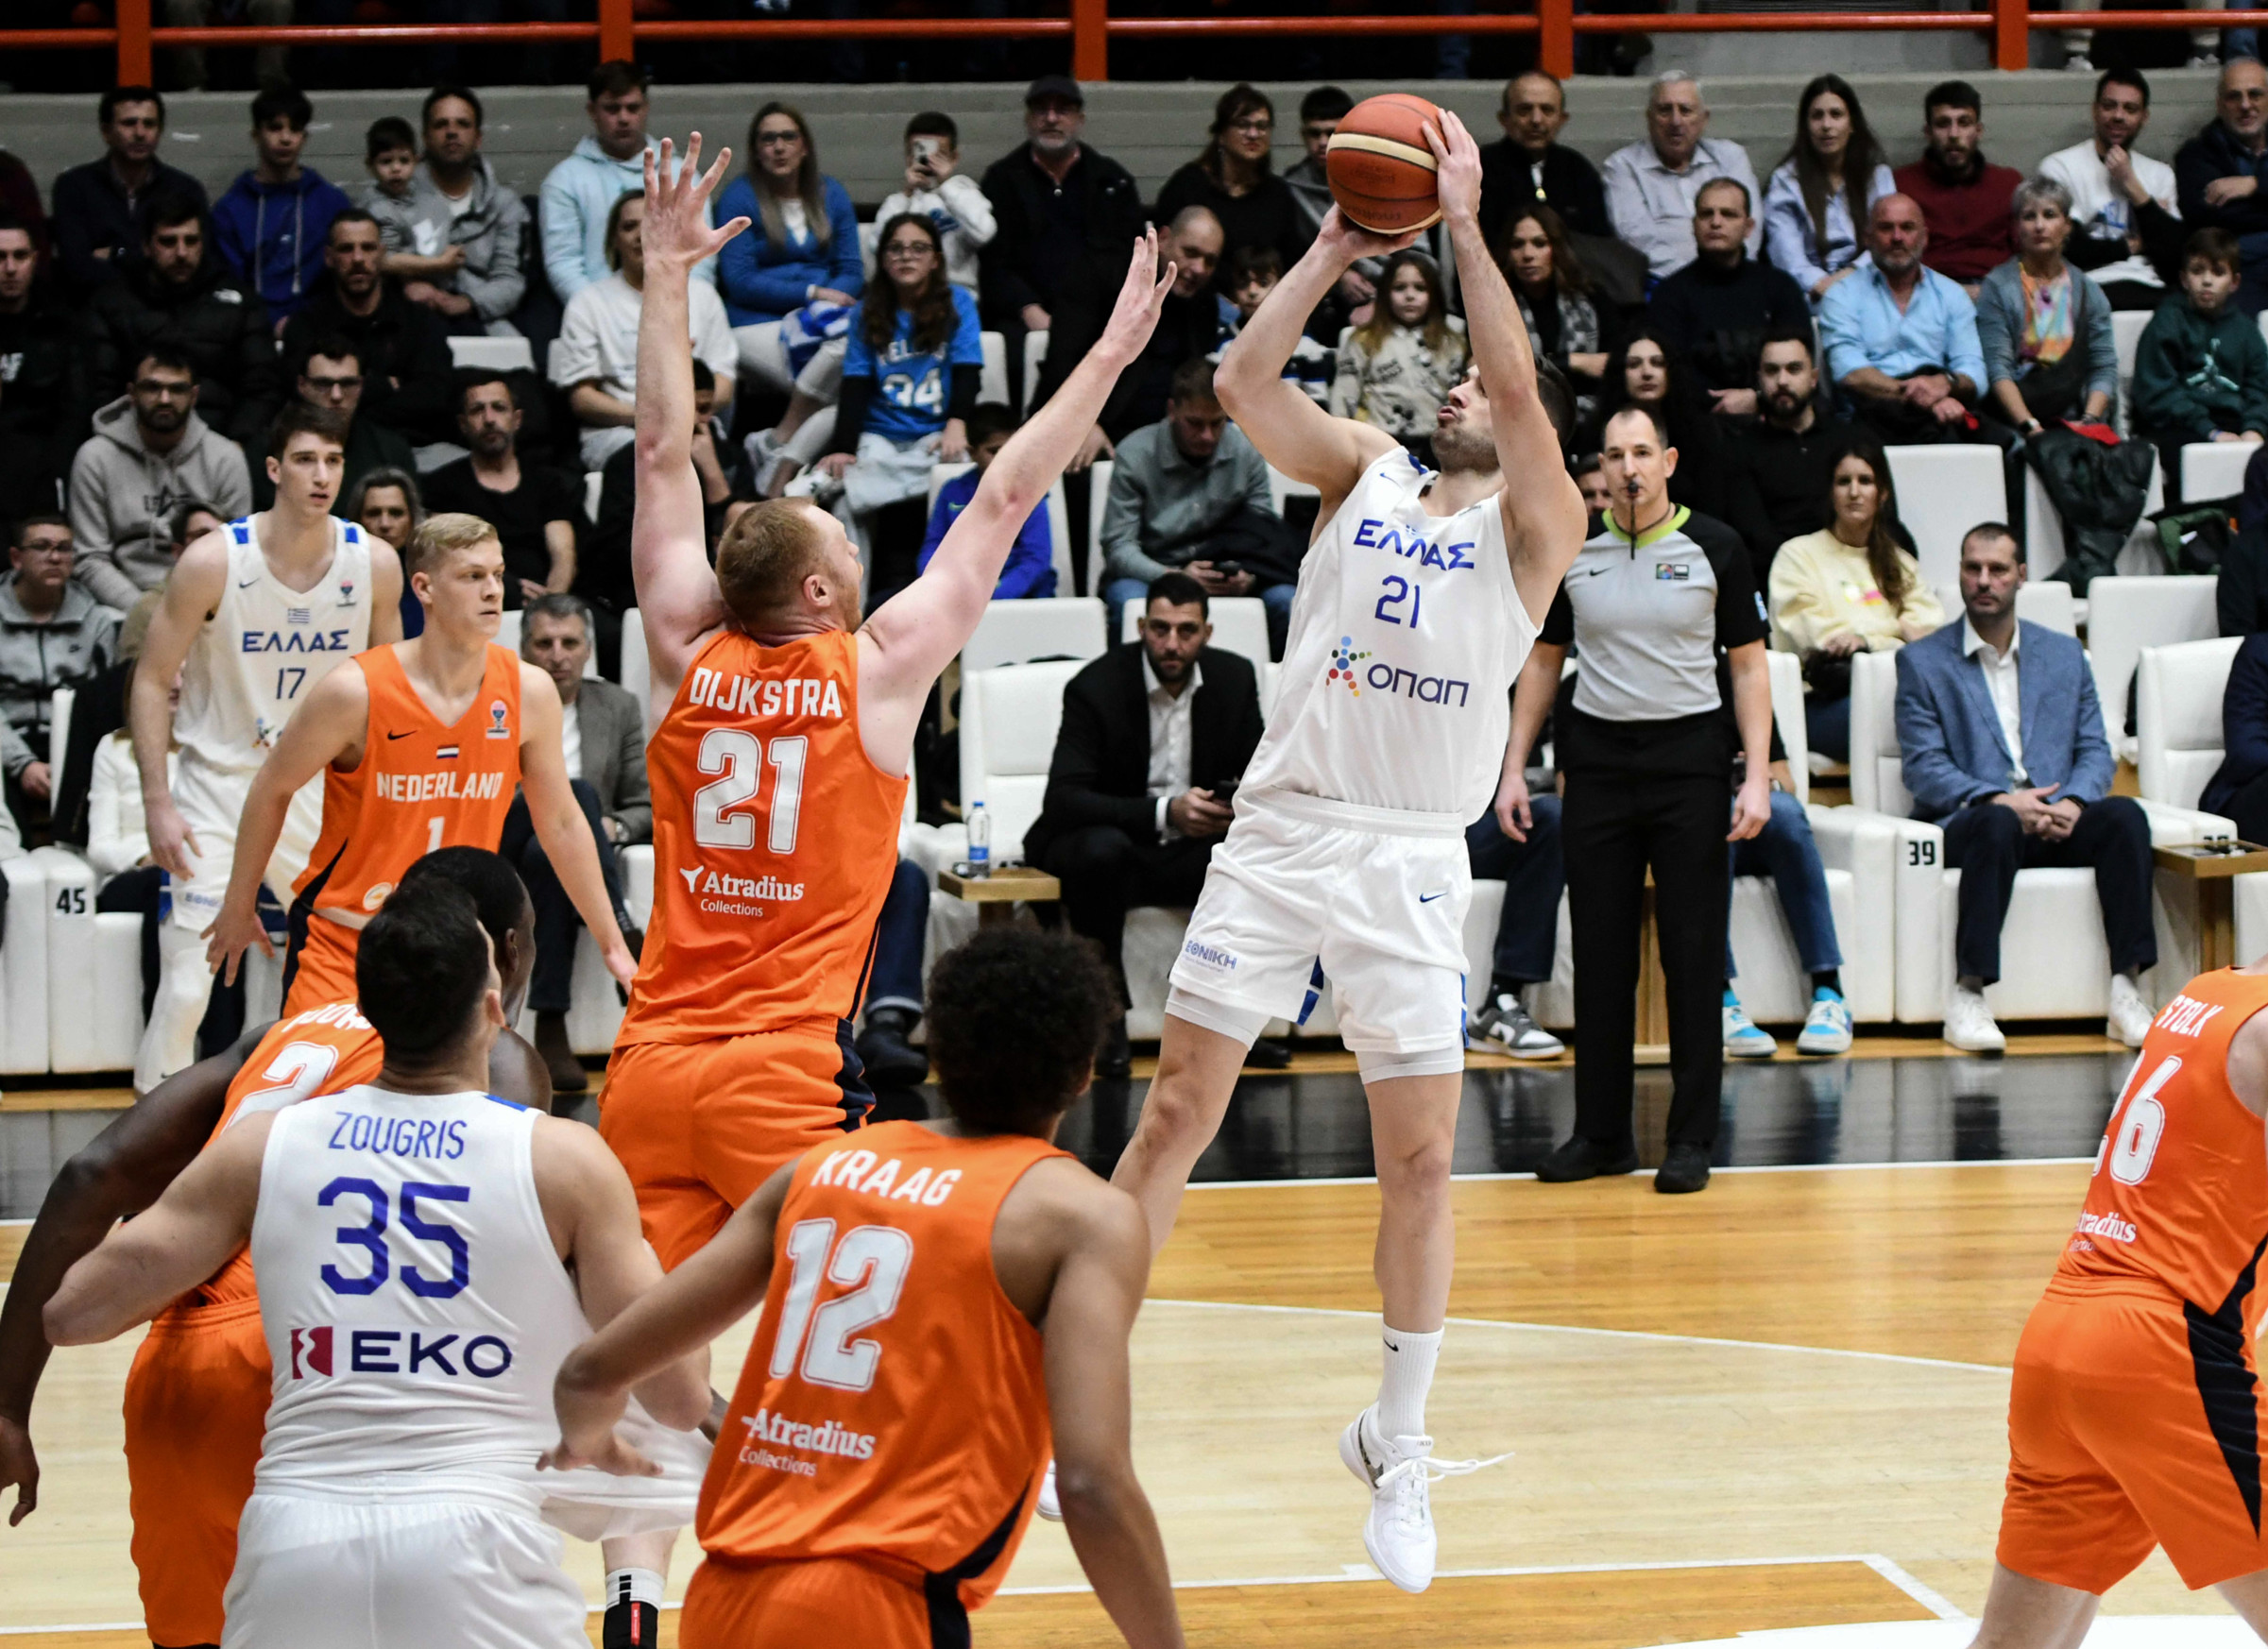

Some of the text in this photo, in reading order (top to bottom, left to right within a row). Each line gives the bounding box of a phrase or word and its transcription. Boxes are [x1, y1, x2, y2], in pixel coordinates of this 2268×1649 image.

[1353, 518, 1475, 571] ΕΛΛΑΣ
[1374, 574, 1421, 629] 21
[242, 629, 350, 653] ΕΛΛΑΣ
[276, 668, 306, 700] 17
[689, 667, 844, 718] DIJKSTRA
[376, 771, 504, 802] NEDERLAND
[693, 727, 809, 855] 21
[426, 815, 446, 855] 1
[1908, 840, 1935, 866] 39
[56, 887, 86, 914] 45
[700, 898, 763, 917] Collections
[702, 871, 805, 901] Atradius
[2156, 994, 2224, 1038] STOLK
[220, 1041, 339, 1136] 2
[328, 1111, 468, 1160] ZOUGRIS
[810, 1148, 963, 1206] KRAAG
[317, 1176, 470, 1299] 35
[769, 1216, 913, 1392] 12
[351, 1330, 513, 1378] EKO
[747, 1407, 877, 1460] Atradius
[739, 1445, 817, 1477] Collections
